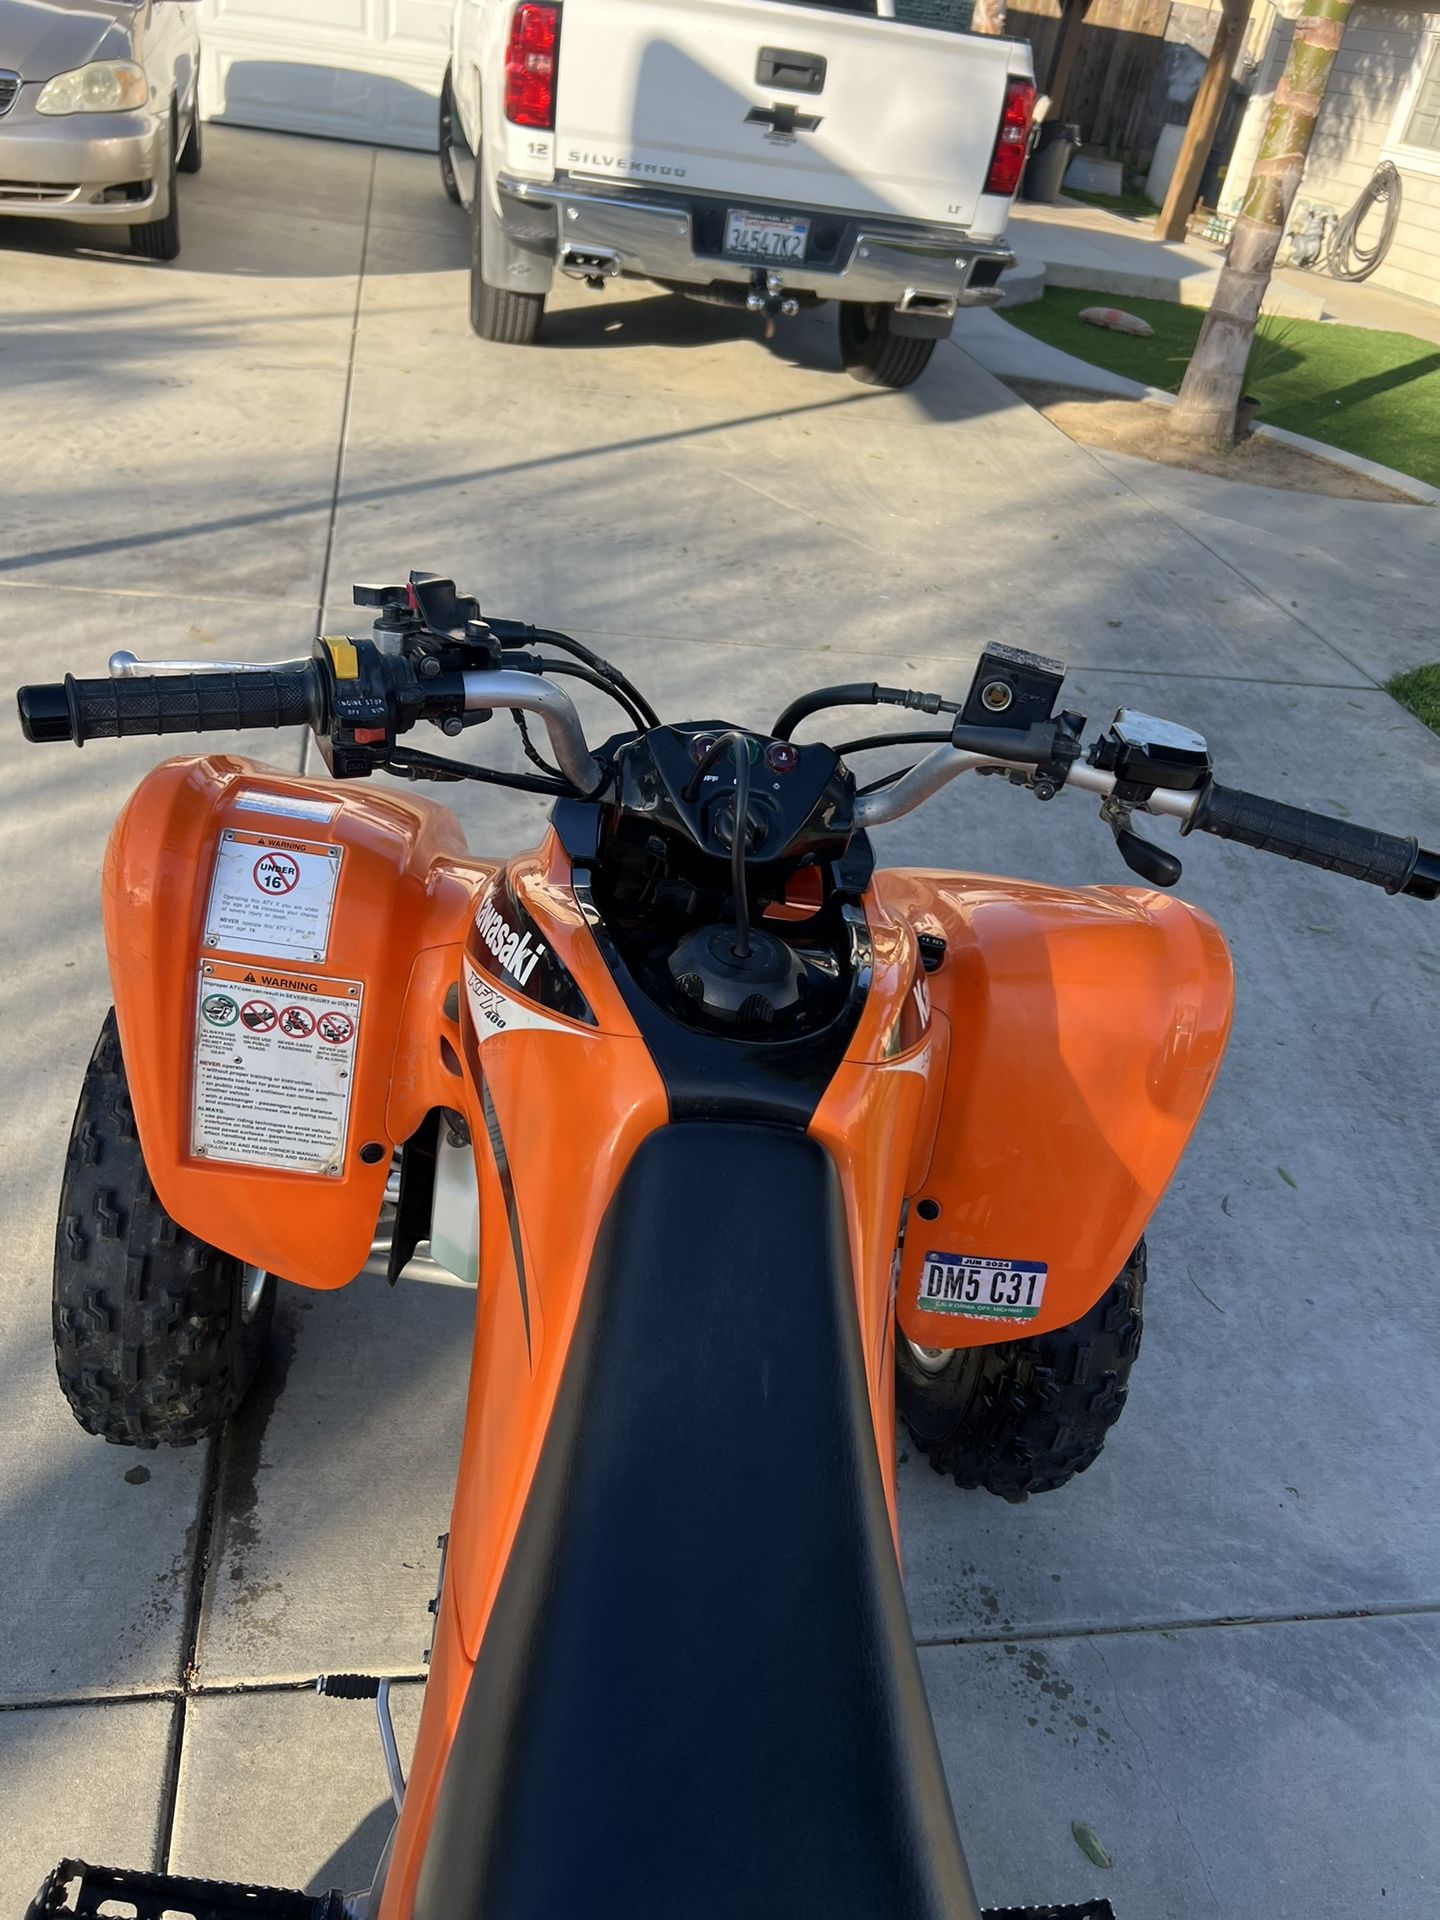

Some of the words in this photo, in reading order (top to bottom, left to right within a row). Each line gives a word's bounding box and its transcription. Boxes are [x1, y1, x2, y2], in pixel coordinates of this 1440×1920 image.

[568, 151, 686, 177] SILVERADO
[948, 204, 963, 214] LT
[268, 839, 306, 851] WARNING
[260, 863, 295, 876] UNDER
[264, 875, 282, 889] 16
[261, 975, 318, 993] WARNING
[468, 971, 506, 1016] KFX
[485, 1011, 506, 1029] 400
[927, 1264, 981, 1302] DM5
[990, 1272, 1037, 1305] C31
[936, 1301, 975, 1310] CALIFORNIA
